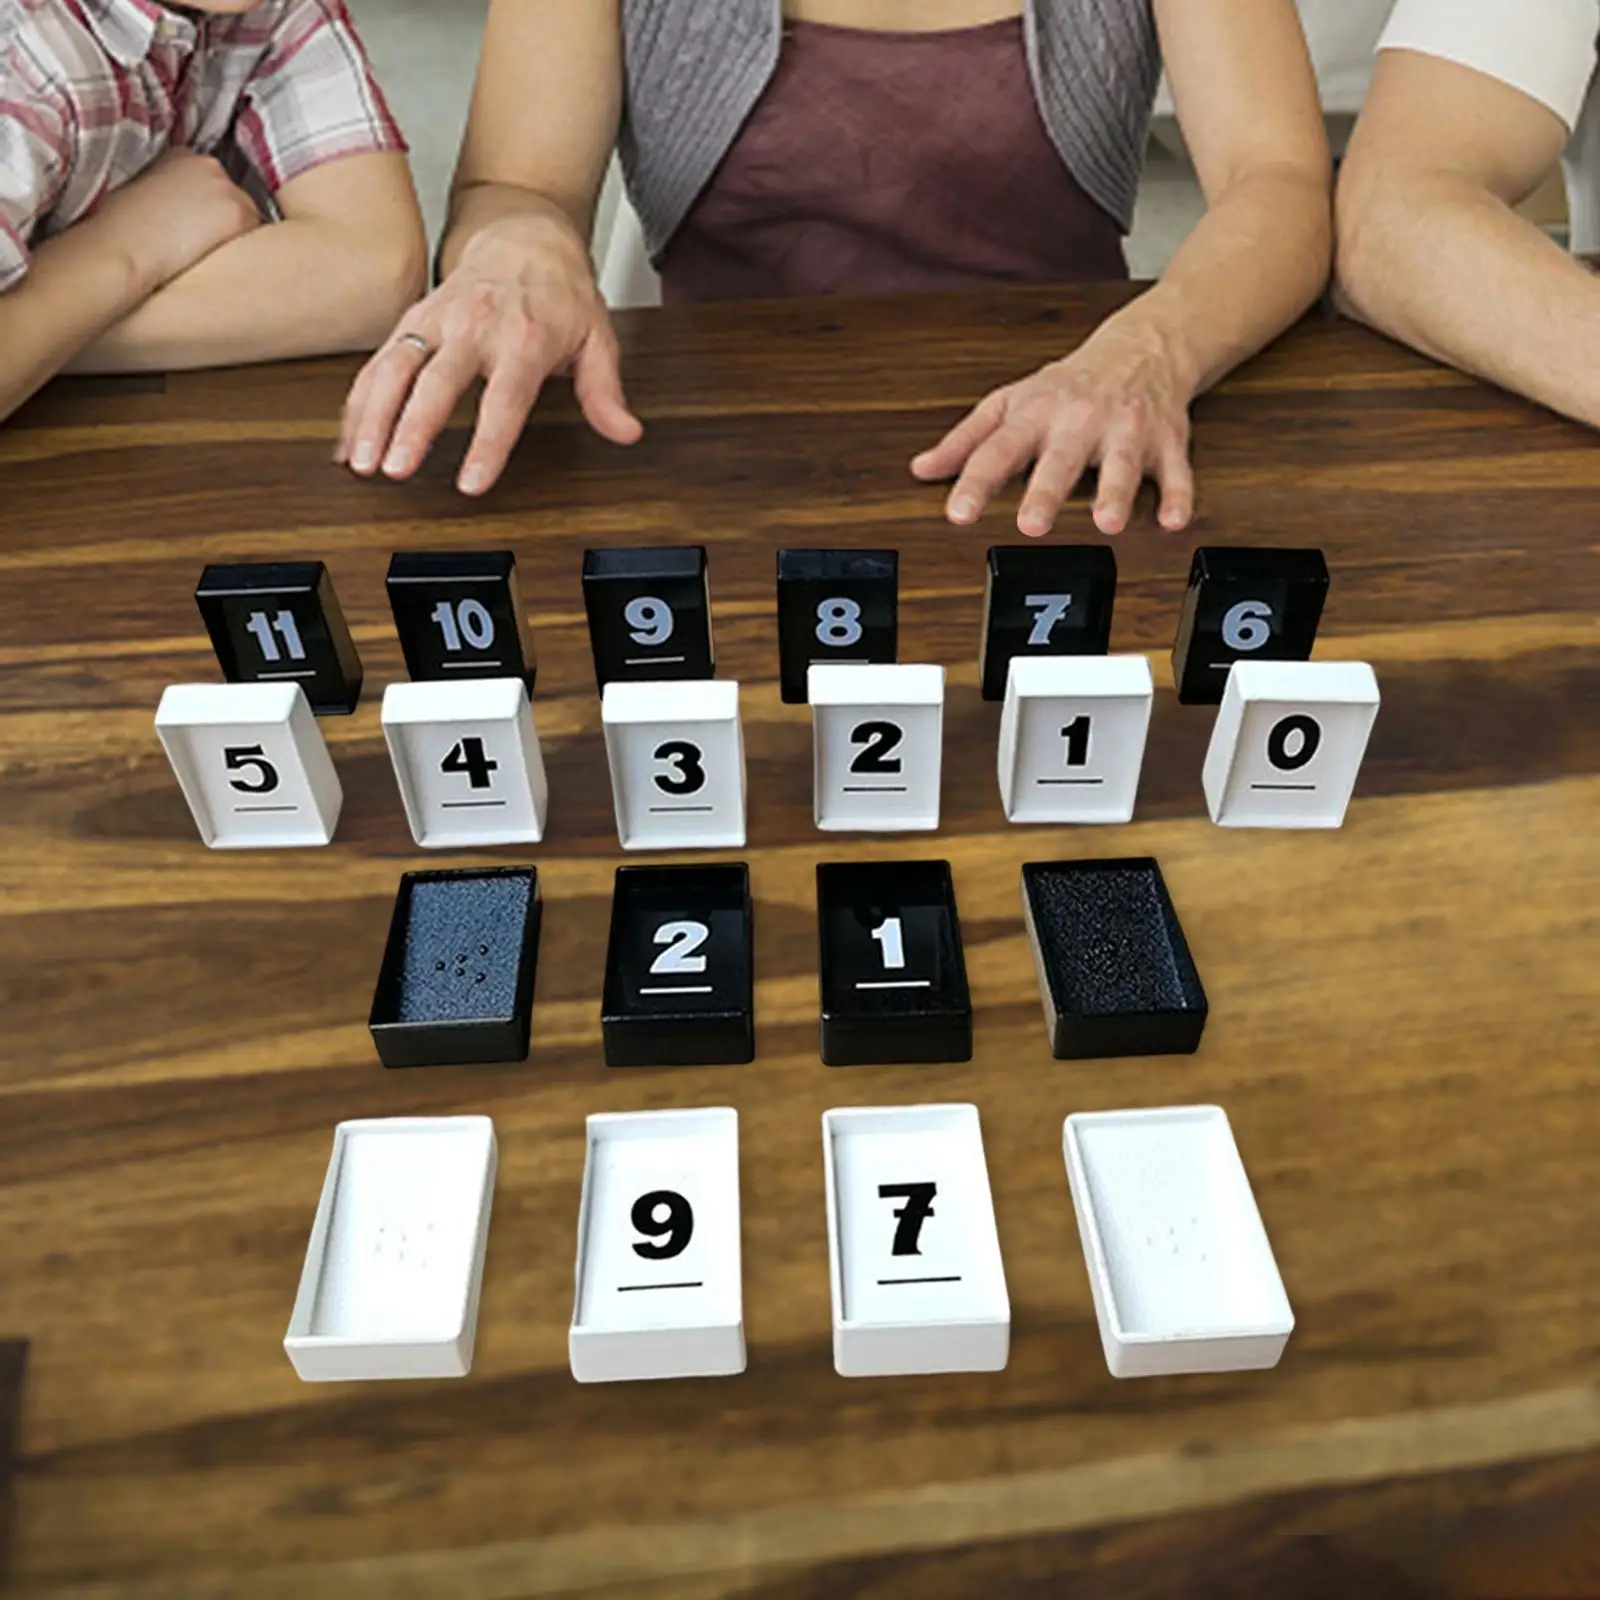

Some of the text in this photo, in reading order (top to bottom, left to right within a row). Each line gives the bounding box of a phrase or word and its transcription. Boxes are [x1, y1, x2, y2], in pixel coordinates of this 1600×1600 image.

[247, 611, 305, 660] 11
[431, 598, 494, 650] 10
[624, 597, 673, 645] 9
[816, 598, 862, 646] 8
[1024, 594, 1072, 644] 7
[1222, 601, 1272, 650] 6
[440, 738, 498, 788] 4
[850, 720, 903, 774] 2
[1060, 715, 1091, 766] 1
[1267, 714, 1321, 770] 0
[225, 744, 279, 792] 5
[653, 741, 705, 794] 3
[650, 920, 709, 974] 2
[871, 917, 905, 969] 1
[630, 1189, 694, 1260] 9
[877, 1182, 938, 1257] 7
